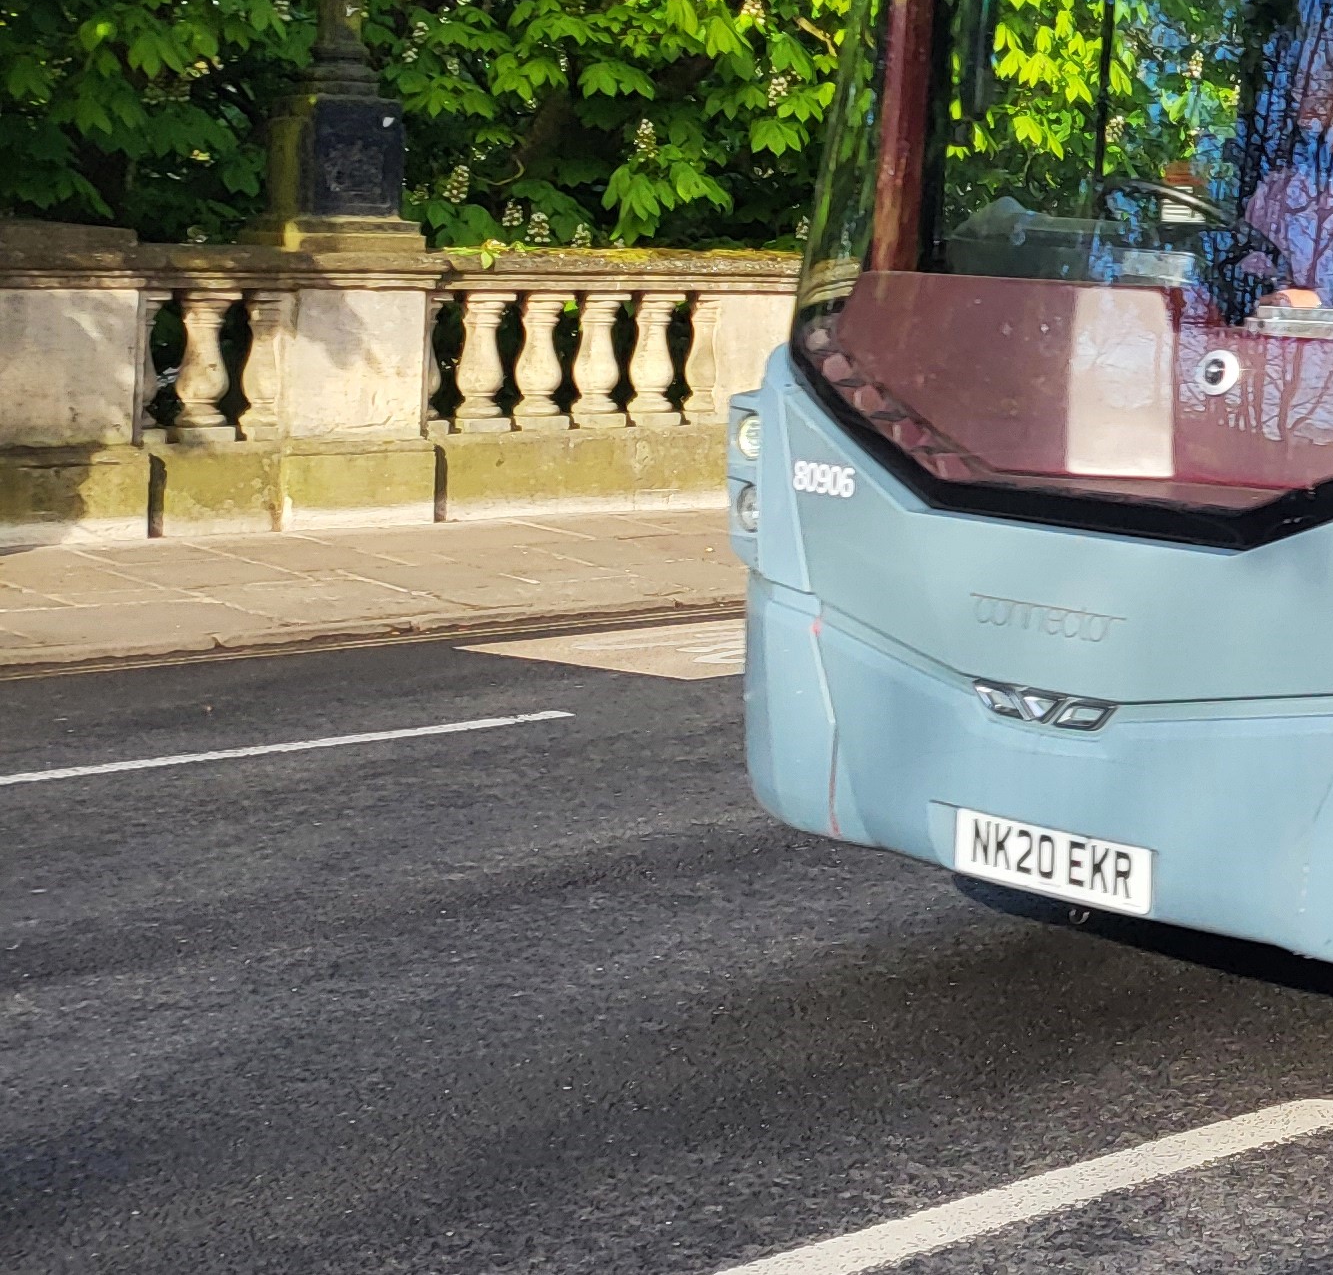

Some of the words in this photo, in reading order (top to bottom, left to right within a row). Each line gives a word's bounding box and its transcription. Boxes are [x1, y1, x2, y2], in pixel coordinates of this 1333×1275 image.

[792, 460, 856, 498] 80906
[970, 818, 1055, 880] NK20
[1068, 841, 1133, 900] EKR
